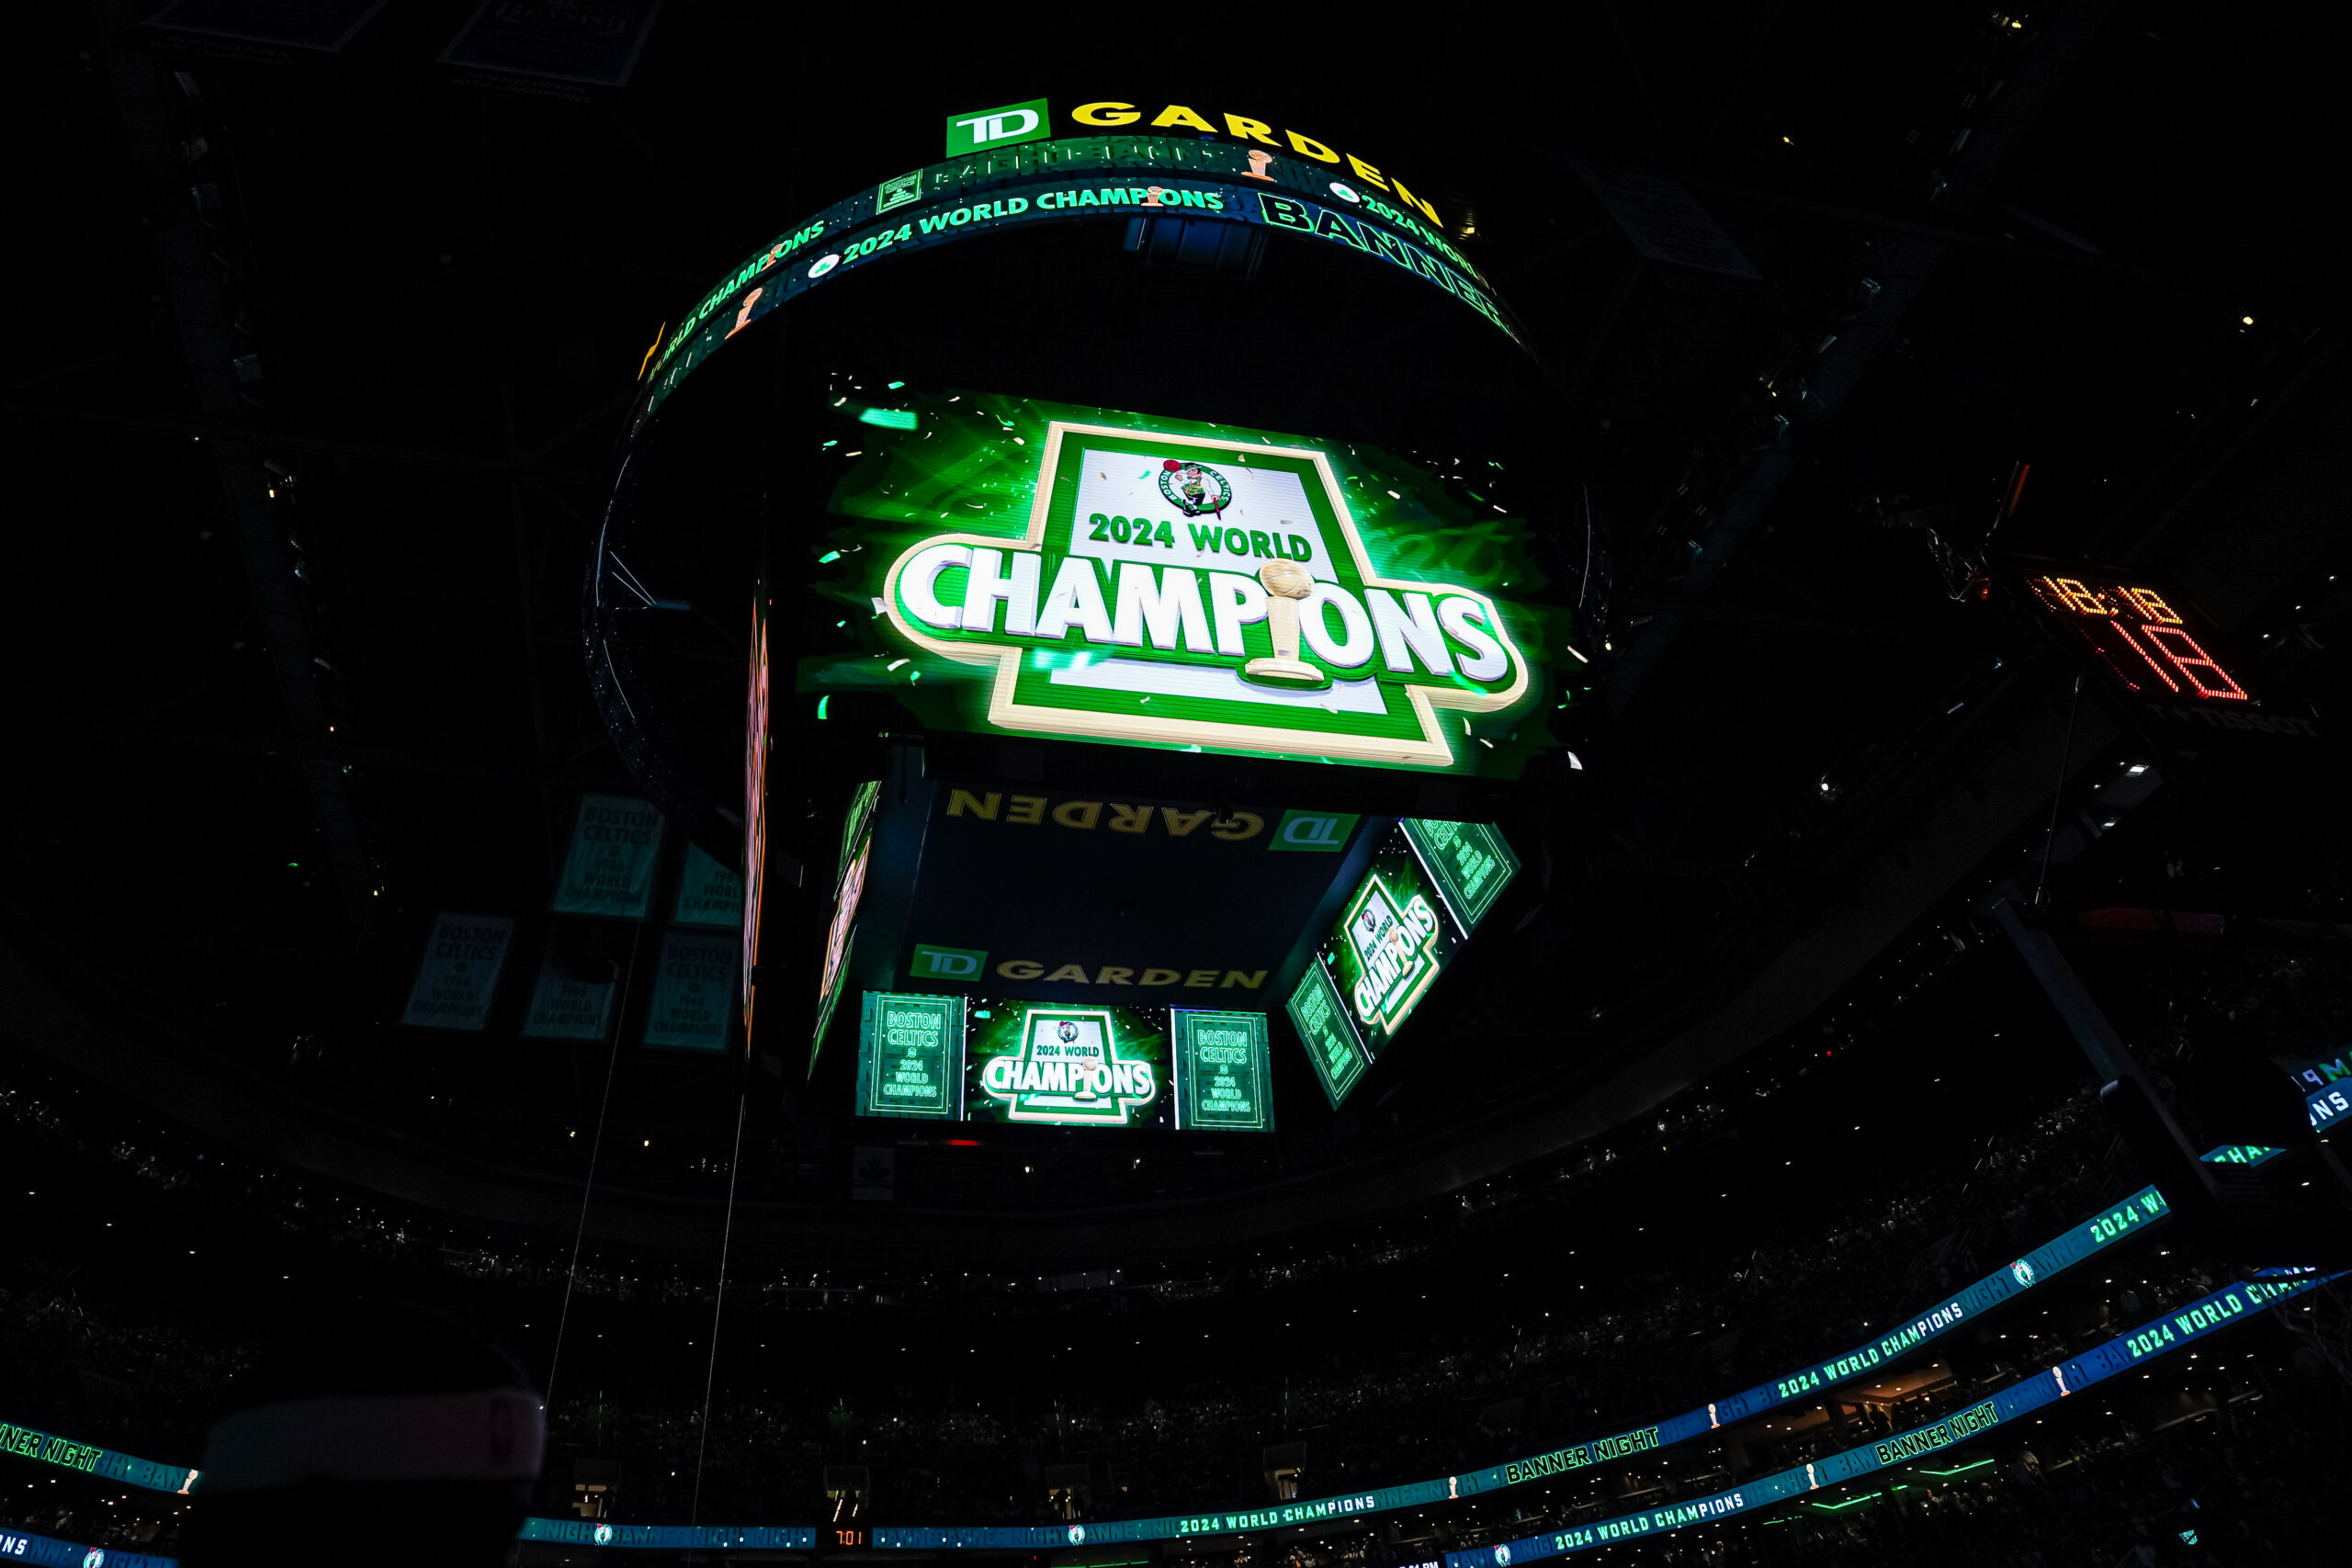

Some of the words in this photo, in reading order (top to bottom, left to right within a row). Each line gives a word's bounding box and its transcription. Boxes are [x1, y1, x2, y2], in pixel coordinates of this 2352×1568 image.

[956, 108, 1040, 143] TD
[1072, 102, 1443, 227] GARDEN
[842, 224, 911, 265] 2024
[919, 197, 1028, 234] WORLD
[1036, 186, 1224, 210] CHAMPIONS
[1361, 194, 1421, 236] 2024
[1258, 192, 1520, 344] BANNER
[1159, 469, 1178, 501] BOSTON
[1209, 470, 1231, 502] CELTICS
[1088, 513, 1176, 549] 2024
[1191, 522, 1313, 563] WORLD
[899, 544, 1509, 683] CHAMPIONS
[2109, 620, 2248, 700] 18
[585, 807, 659, 828] BOSTON
[946, 788, 1265, 841] GARDEN
[583, 826, 651, 845] CELTICS
[439, 925, 504, 943] BOSTON
[1374, 915, 1394, 943] WORLD
[435, 942, 497, 961] CELTICS
[668, 945, 732, 964] BOSTON
[921, 950, 977, 975] TD
[996, 959, 1270, 989] GARDEN
[1356, 899, 1434, 1018] CHAMPIONS
[887, 1010, 942, 1030] BOSTON
[888, 1029, 938, 1047] CELTICS
[1197, 1029, 1248, 1047] BOSTON
[899, 1059, 923, 1071] 2024
[1036, 1044, 1061, 1056] 2024
[1065, 1045, 1100, 1057] WORLD
[1200, 1046, 1247, 1064] CELTICS
[883, 1083, 937, 1097] CHAMPIONS
[896, 1071, 928, 1084] WORLD
[987, 1060, 1150, 1097] CHAMPIONS
[1211, 1088, 1241, 1100] WORLD
[1201, 1100, 1250, 1112] CHAMPIONS
[2090, 1205, 2139, 1243] 2024
[2127, 1323, 2175, 1358] 2024
[2175, 1293, 2243, 1335] WORLD
[1779, 1371, 1820, 1399] 2024
[1824, 1348, 1880, 1382] WORLD
[1881, 1303, 1963, 1358] CHAMPIONS
[1875, 1424, 1952, 1465] BANNER
[1951, 1401, 1998, 1440] NIGHT
[41, 1437, 103, 1472] NIGHT
[1506, 1446, 1591, 1484] BANNER
[1592, 1427, 1659, 1462] NIGHT
[1181, 1518, 1220, 1533] 2024
[1226, 1510, 1278, 1529] WORLD
[1284, 1495, 1375, 1522] CHAMPIONS
[1555, 1529, 1593, 1551] 2024
[1597, 1517, 1649, 1541] WORLD
[1654, 1493, 1745, 1528] CHAMPIONS
